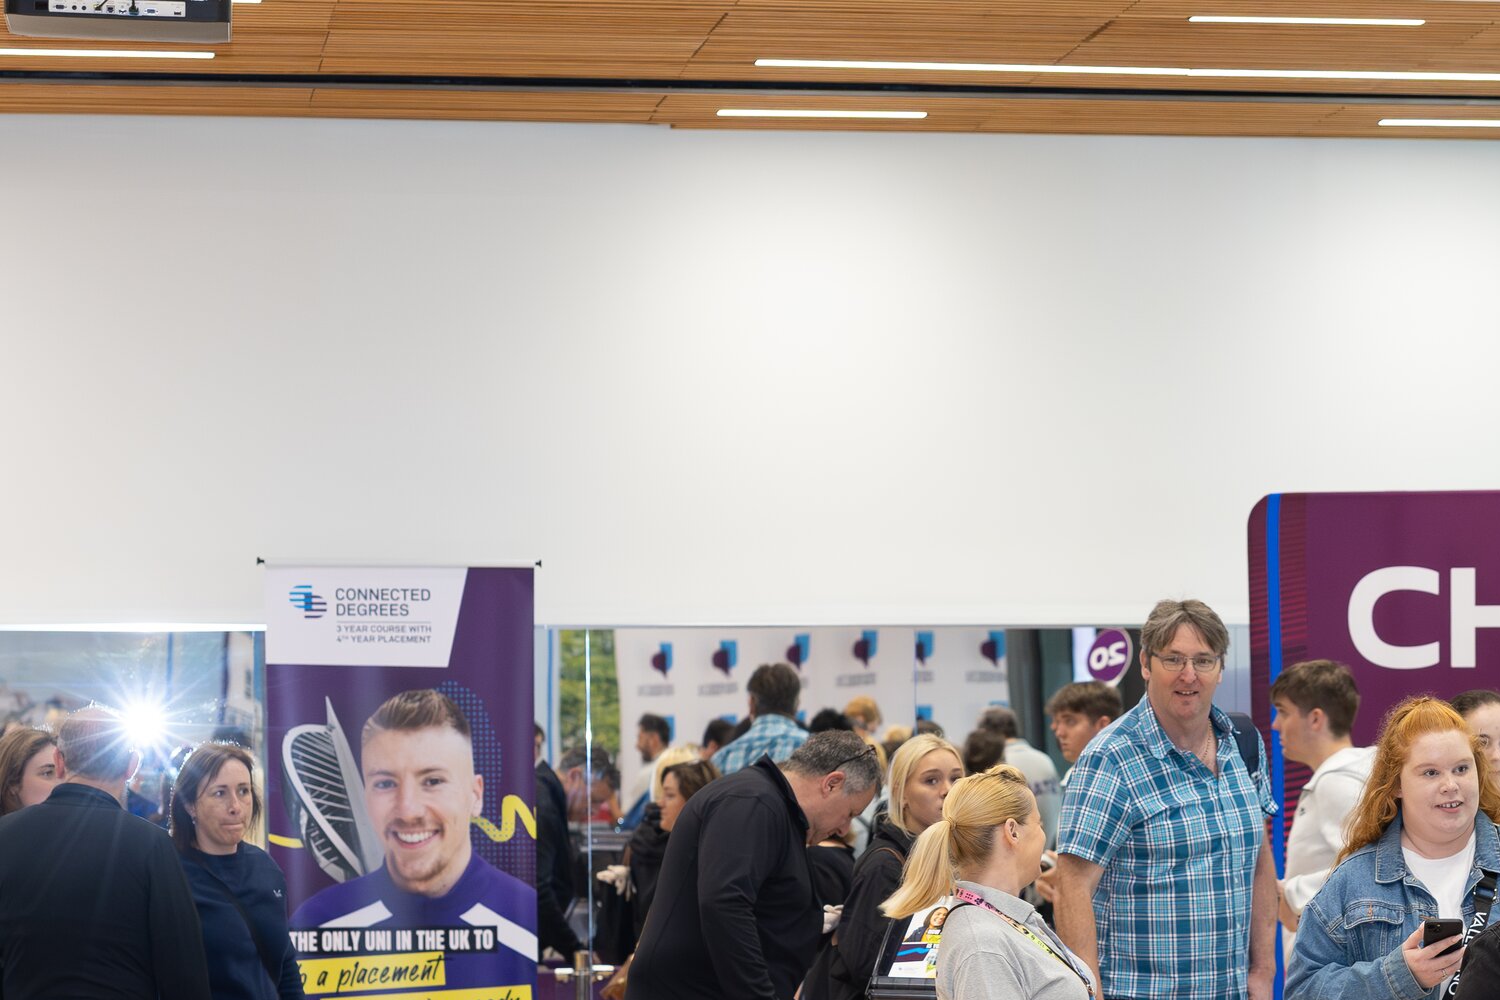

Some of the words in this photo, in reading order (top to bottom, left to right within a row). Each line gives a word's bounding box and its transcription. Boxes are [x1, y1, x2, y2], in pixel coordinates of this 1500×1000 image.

[335, 588, 431, 601] CONNECTED
[336, 603, 409, 617] DEGREES
[336, 625, 342, 633] 3
[344, 625, 368, 633] YEAR
[370, 625, 407, 633] COURSE
[408, 625, 432, 633] WITH
[351, 635, 375, 643] YEAR
[377, 635, 431, 643] PLACEMENT
[288, 930, 318, 952] THE
[321, 930, 361, 952] ONLY
[364, 930, 392, 951] UNI
[396, 930, 412, 950] IN
[416, 929, 444, 950] THE
[449, 929, 470, 950] UK
[474, 929, 494, 950] TO
[316, 970, 328, 986] a
[336, 954, 454, 994] placement
